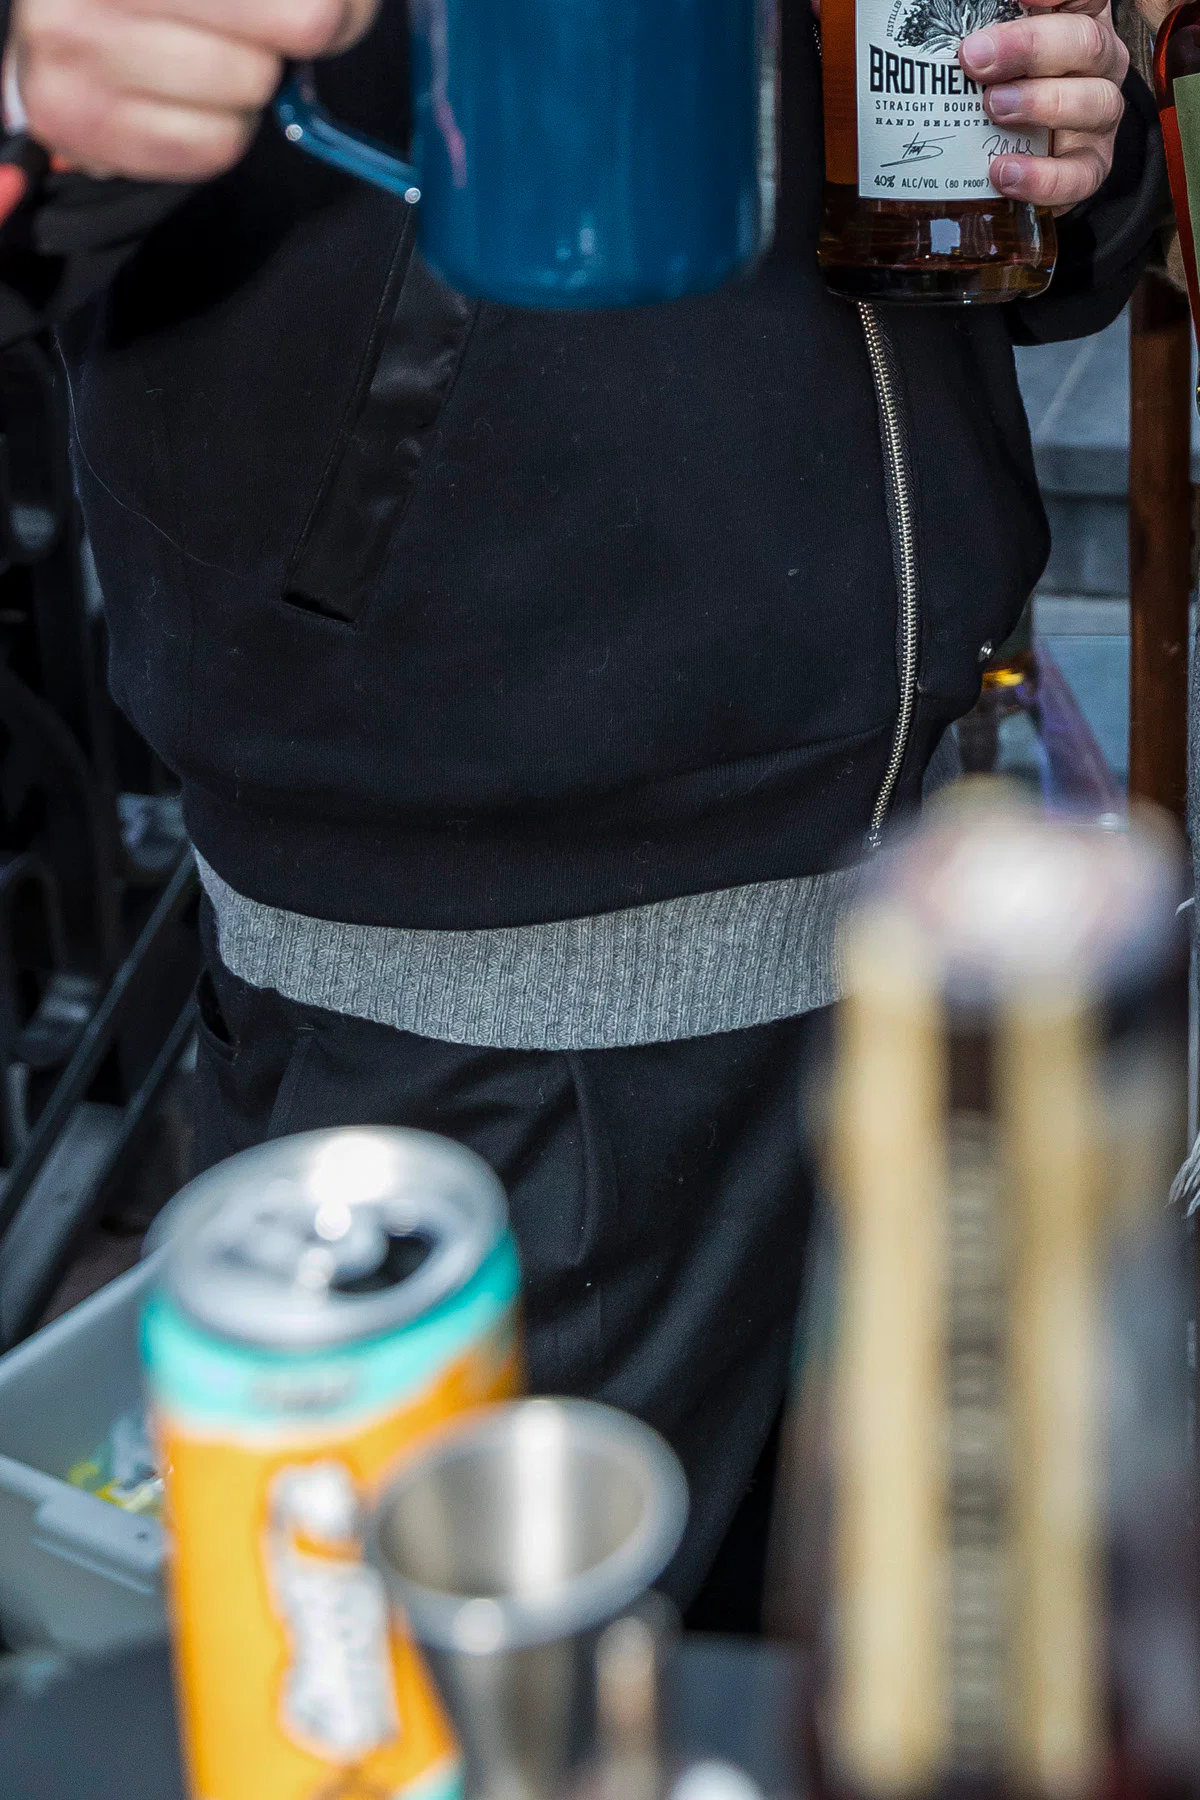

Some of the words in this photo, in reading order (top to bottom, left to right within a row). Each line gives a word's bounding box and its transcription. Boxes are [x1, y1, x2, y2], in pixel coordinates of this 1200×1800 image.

[886, 0, 903, 37] DISTILLED
[875, 100, 934, 112] STRAIGHT
[944, 101, 984, 112] BOURB
[875, 118, 915, 127] HAND
[923, 119, 997, 127] SELECTE
[874, 175, 896, 188] 40%
[901, 177, 939, 189] ALC/VOL
[945, 177, 959, 189] (80
[963, 177, 990, 189] PROOF)
